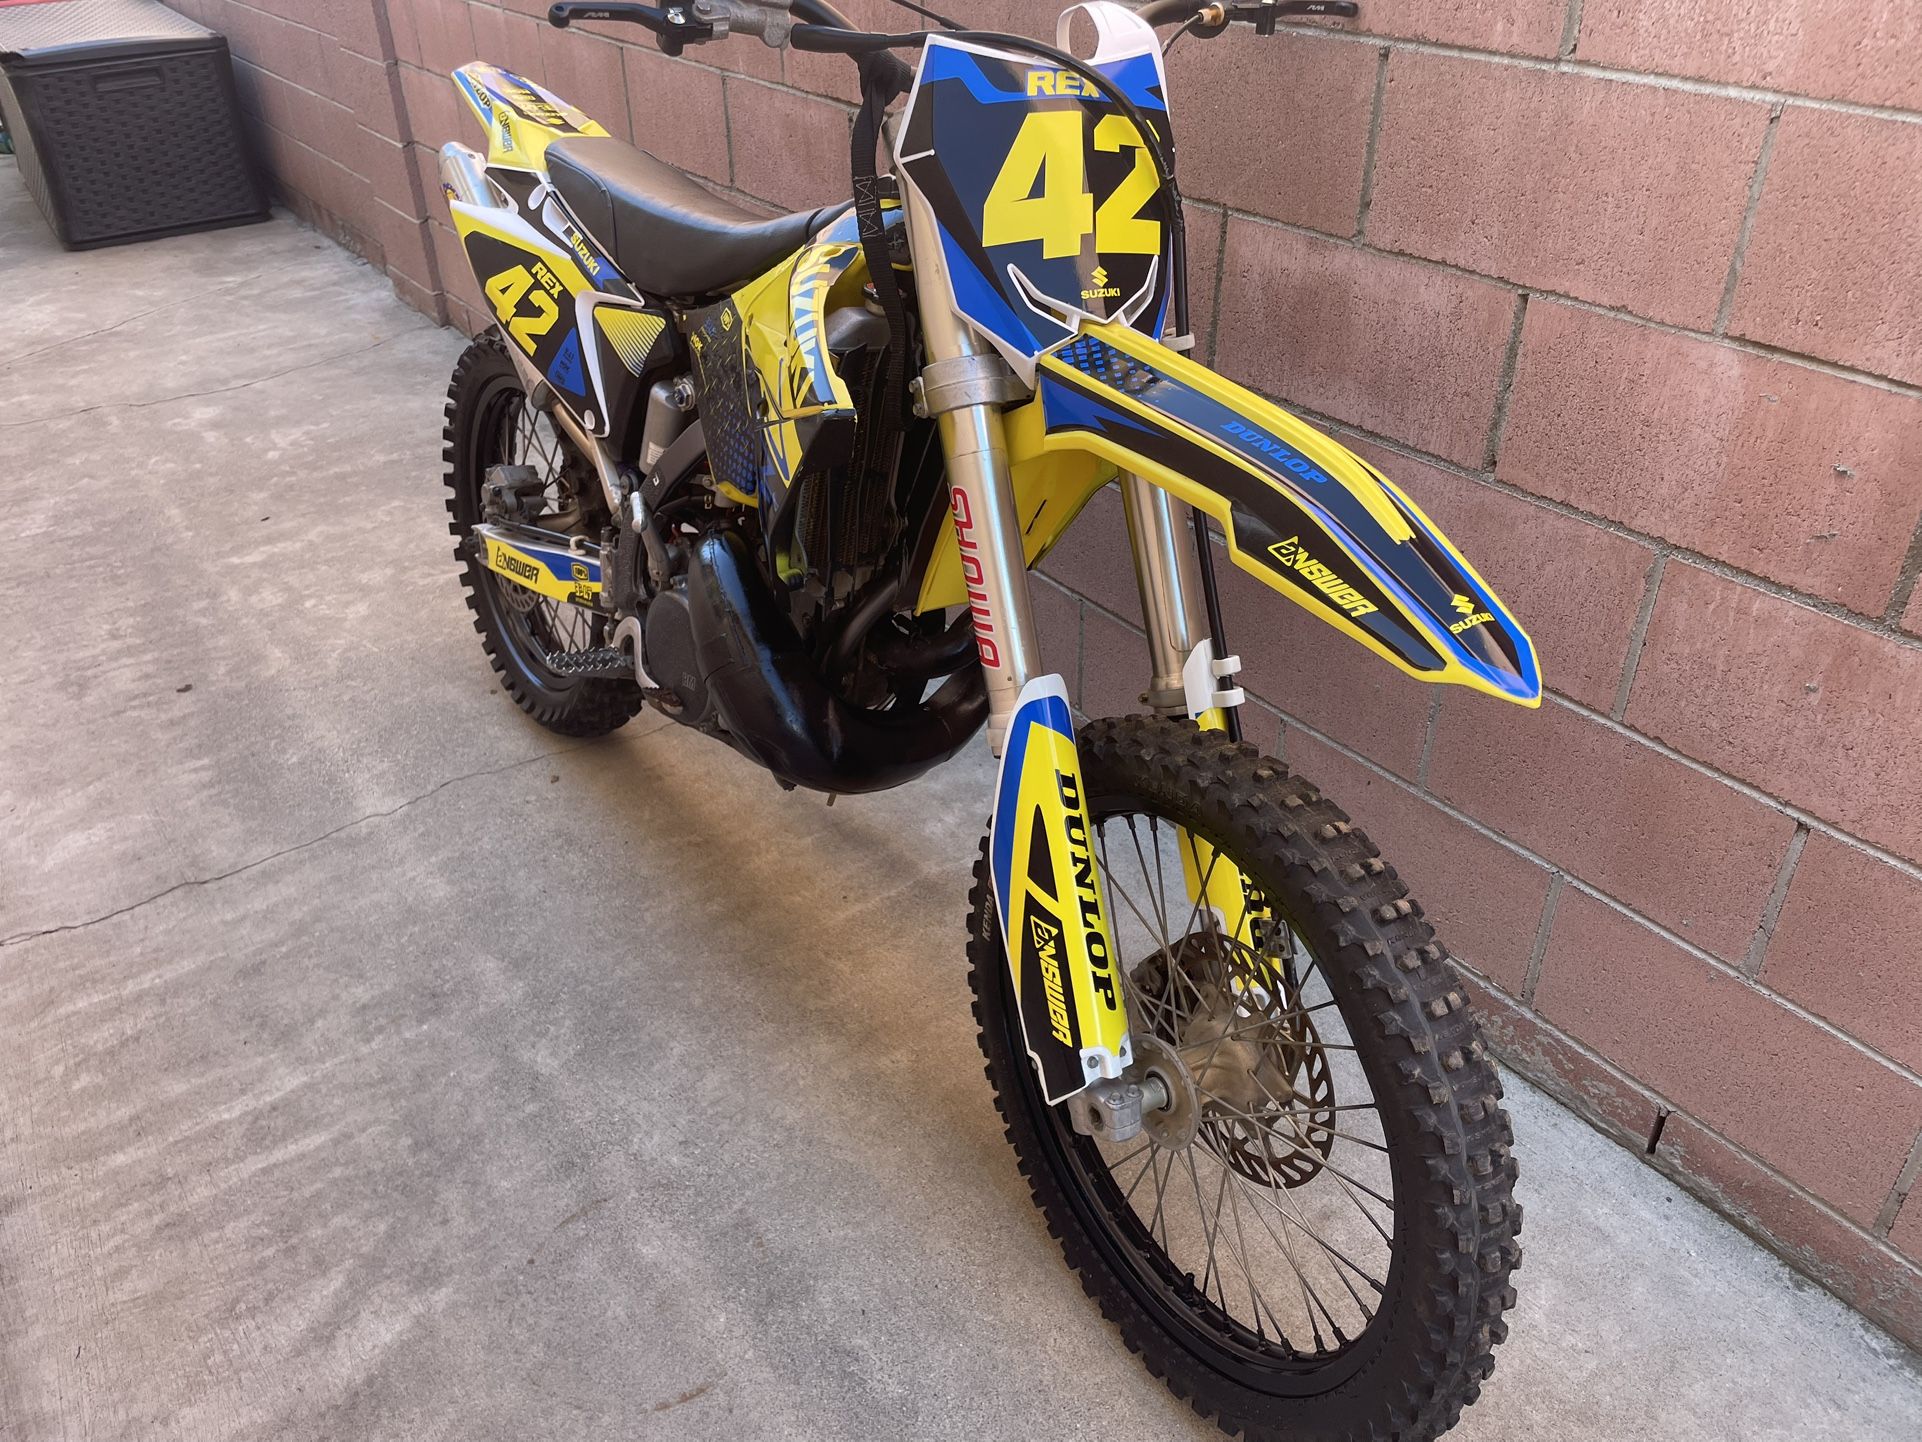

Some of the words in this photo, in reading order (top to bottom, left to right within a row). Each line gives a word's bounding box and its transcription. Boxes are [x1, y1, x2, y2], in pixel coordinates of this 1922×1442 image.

[982, 110, 1161, 259] 42
[531, 261, 564, 299] REX
[570, 231, 600, 276] SUZUKI
[484, 264, 560, 357] 42
[1080, 287, 1121, 300] SUZUKI
[1221, 420, 1328, 484] DUNLOP
[1267, 536, 1380, 618] ANSWER
[1449, 612, 1496, 634] SUZUKI
[982, 894, 995, 942] KENDA
[1055, 768, 1116, 1012] DUNLOP
[1030, 914, 1073, 1048] ANSWER
